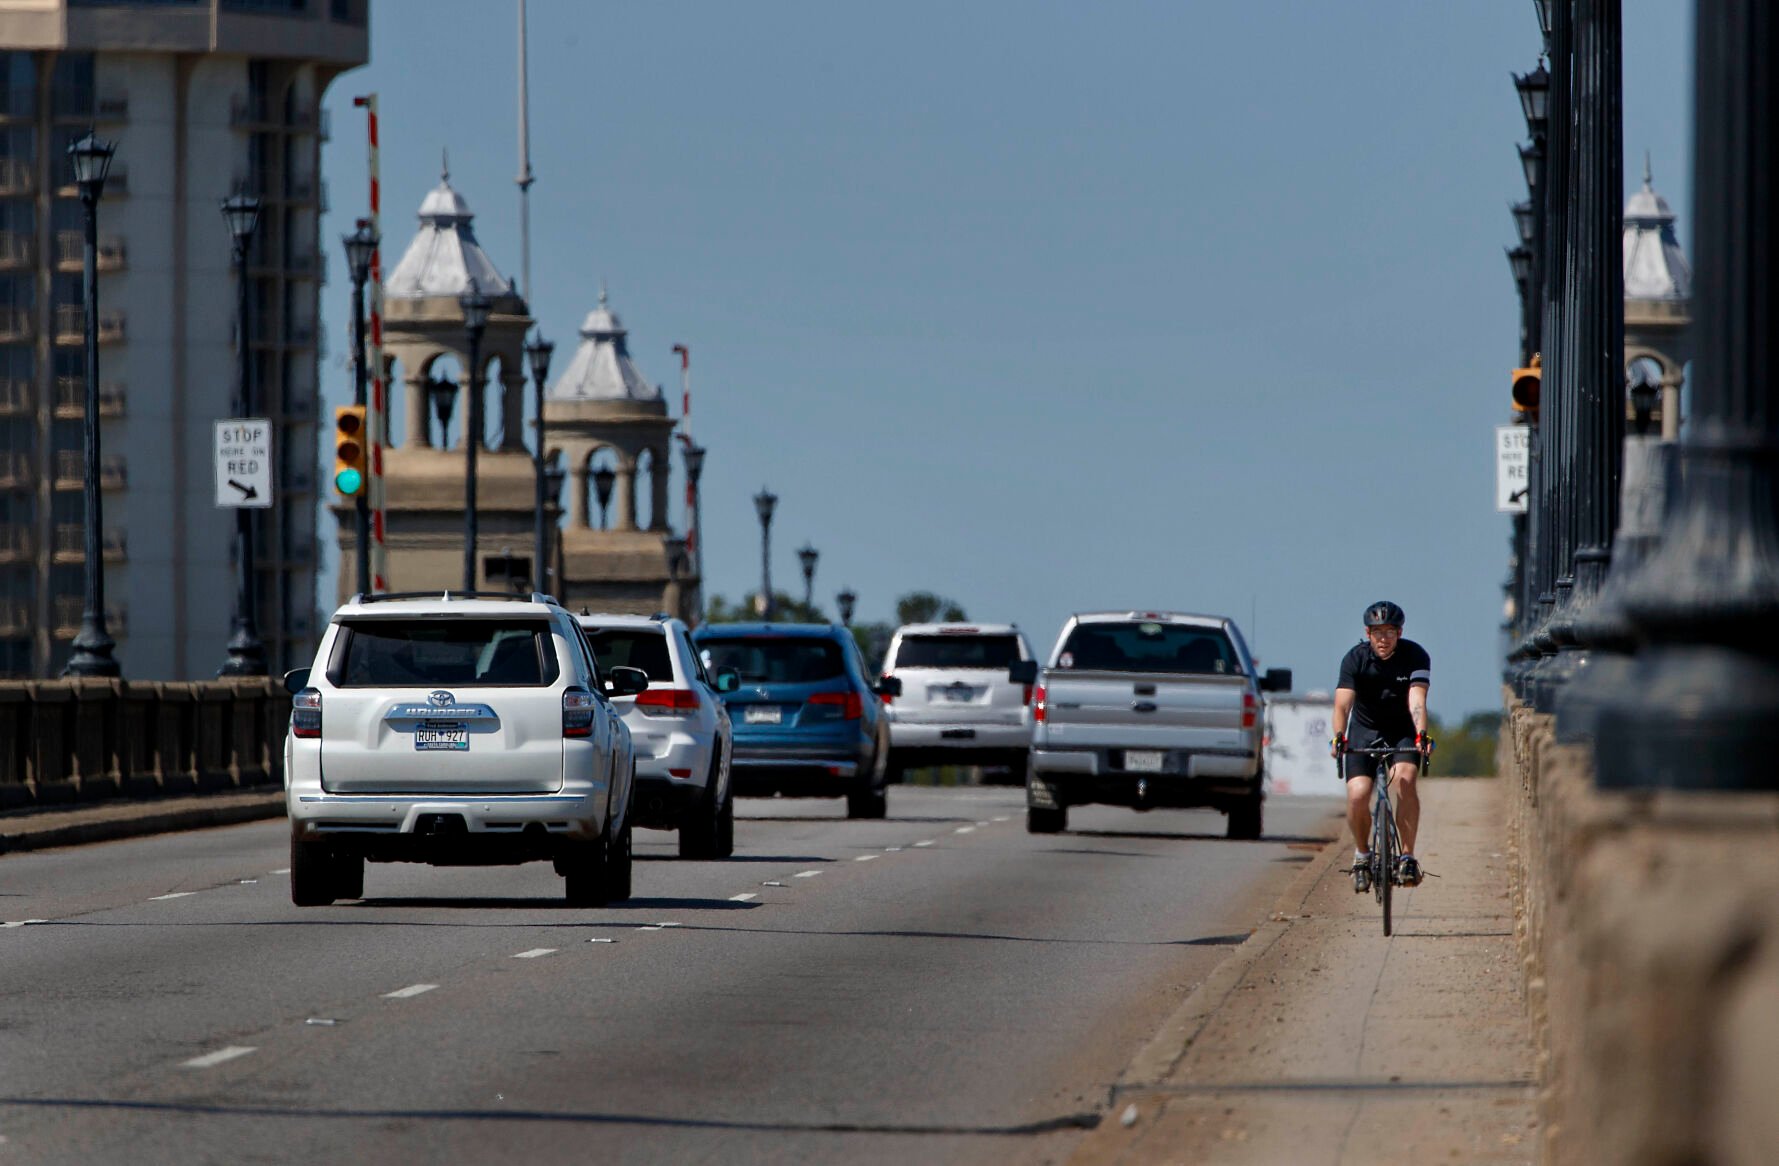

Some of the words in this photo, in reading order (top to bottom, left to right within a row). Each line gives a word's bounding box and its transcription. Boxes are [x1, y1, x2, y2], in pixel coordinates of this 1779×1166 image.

[223, 428, 262, 443] STOP
[1503, 433, 1530, 449] STO
[227, 460, 259, 474] RED
[1508, 465, 1525, 479] RE
[418, 730, 437, 742] RUH
[446, 730, 464, 742] 927
